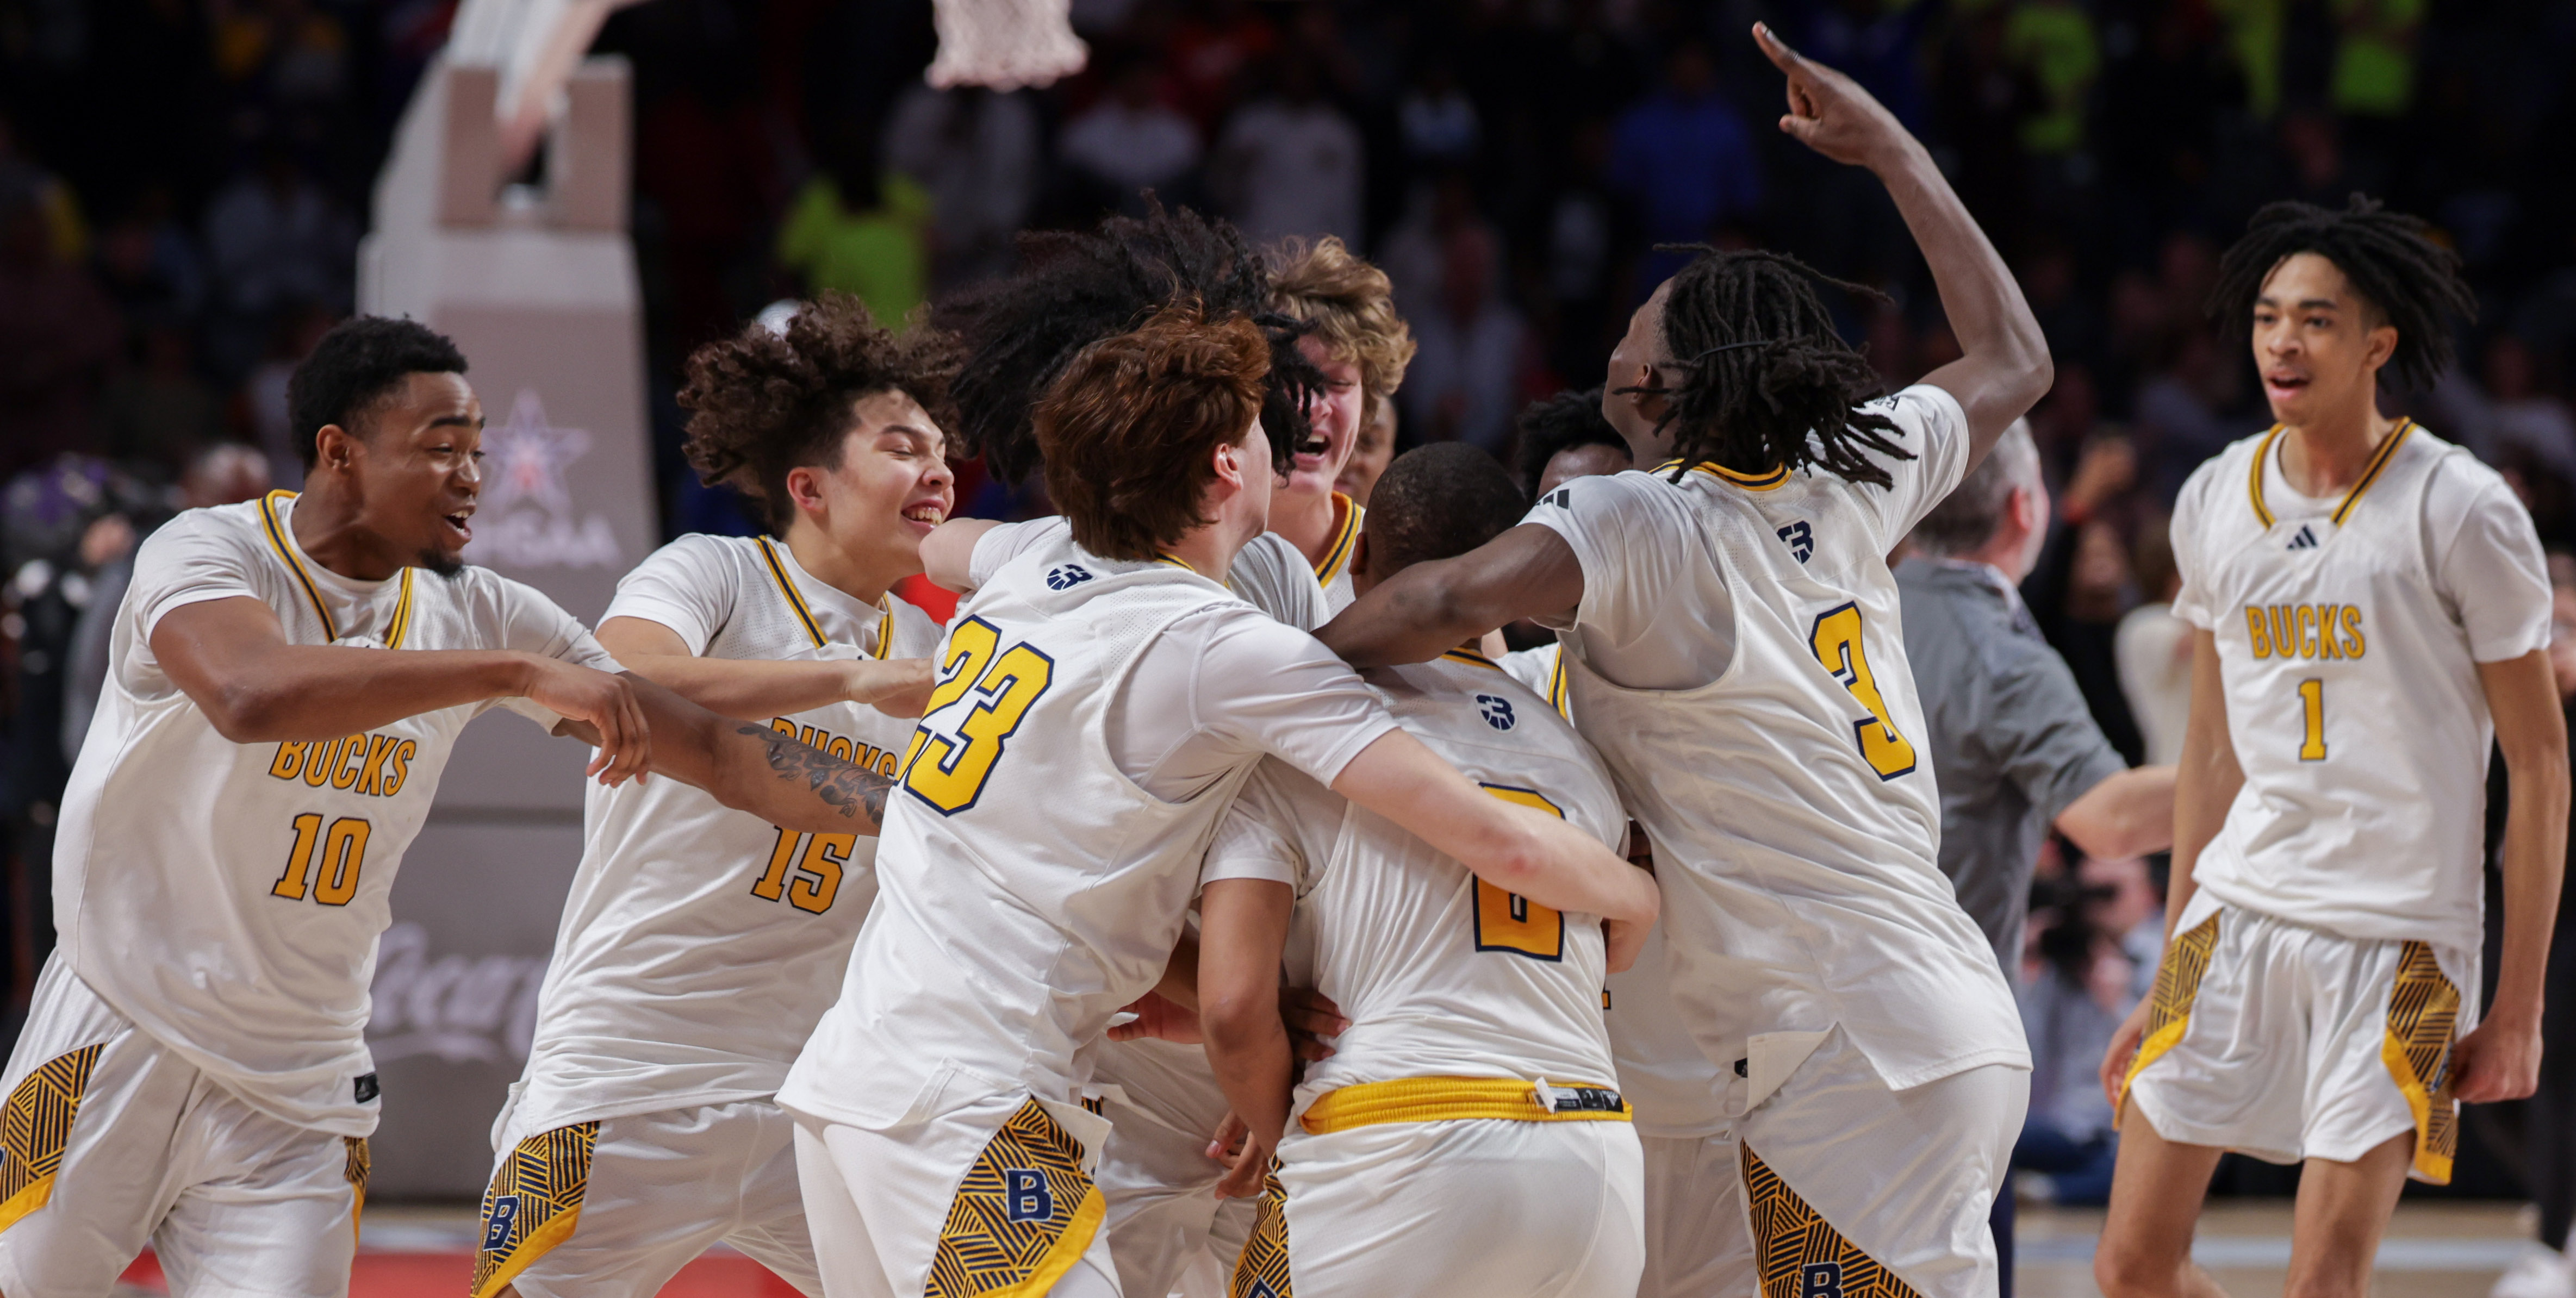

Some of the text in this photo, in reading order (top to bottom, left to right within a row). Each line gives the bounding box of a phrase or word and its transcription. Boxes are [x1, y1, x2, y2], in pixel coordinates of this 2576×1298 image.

[2245, 605, 2365, 659] BUCKS
[893, 614, 1055, 817] 23
[1809, 600, 1916, 782] 3
[2298, 678, 2327, 760] 1
[268, 733, 416, 797] BUCKS
[271, 812, 371, 907] 10
[750, 825, 857, 916] 15
[483, 1195, 520, 1251] B
[1003, 1168, 1054, 1224] B
[1800, 1261, 1844, 1298] B
